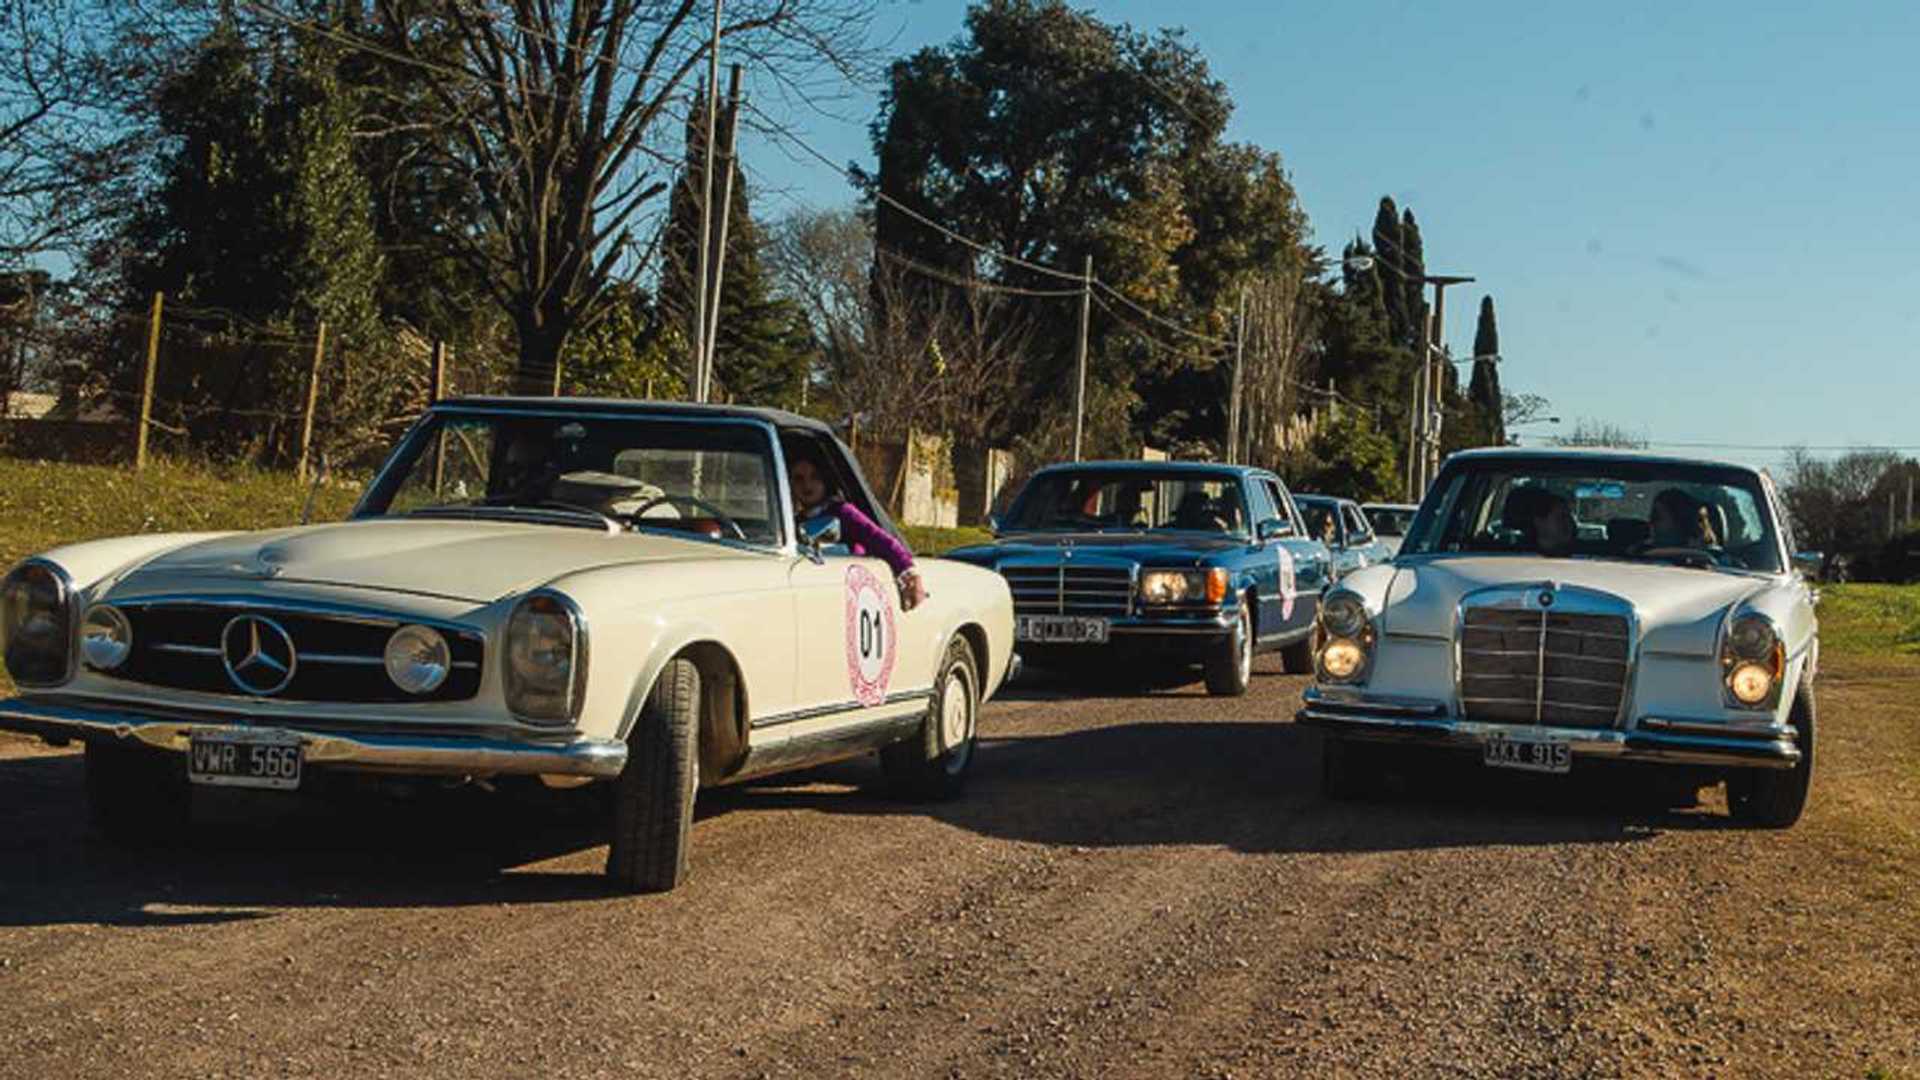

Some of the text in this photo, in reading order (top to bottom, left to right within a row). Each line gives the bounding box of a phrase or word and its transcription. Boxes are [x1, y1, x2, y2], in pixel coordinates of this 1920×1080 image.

[860, 608, 882, 659] 01
[251, 745, 297, 776] 566
[1532, 742, 1567, 766] 915
